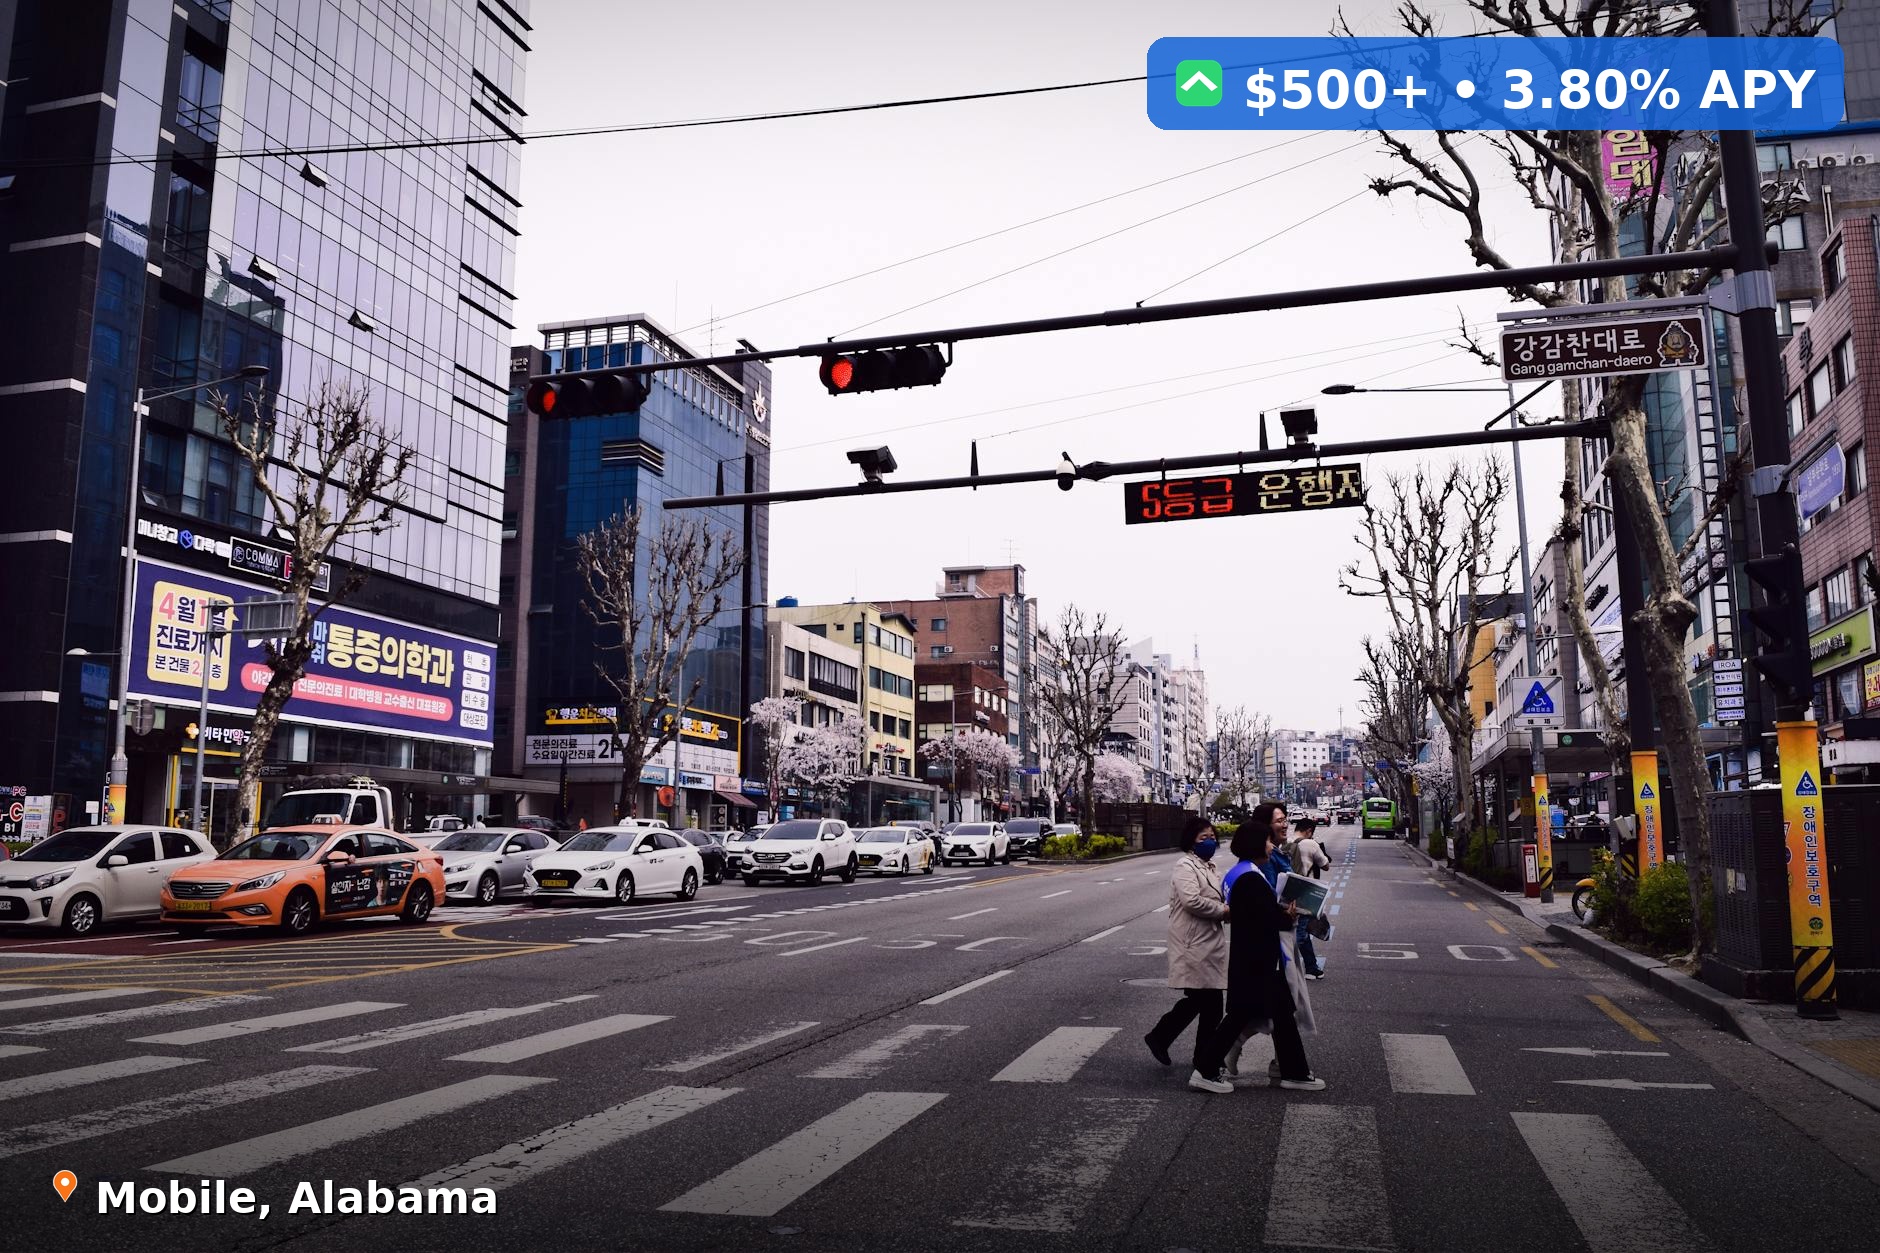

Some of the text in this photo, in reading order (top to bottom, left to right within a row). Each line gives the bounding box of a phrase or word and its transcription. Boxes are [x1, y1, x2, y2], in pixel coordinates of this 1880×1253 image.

[1513, 329, 1646, 361] 강감찬대로
[1510, 354, 1653, 376] Gang gamchan-daero
[1141, 477, 1235, 519] 5등급
[246, 547, 279, 568] COMMA
[159, 592, 196, 624] 4월
[312, 620, 327, 664] 마취
[327, 622, 455, 688] 통증의학과
[155, 655, 166, 670] 본
[169, 656, 190, 674] 건물
[298, 677, 344, 698] 전문의진료
[349, 685, 383, 704] 대학병원
[383, 692, 416, 710] 교수출신
[416, 698, 447, 715] 대표원장
[532, 738, 578, 750] 전문의진료
[532, 749, 596, 760] 수요일야간진료
[4, 822, 16, 833] B1
[1802, 805, 1821, 907] 장애인보호구역
[1356, 942, 1519, 962] 50
